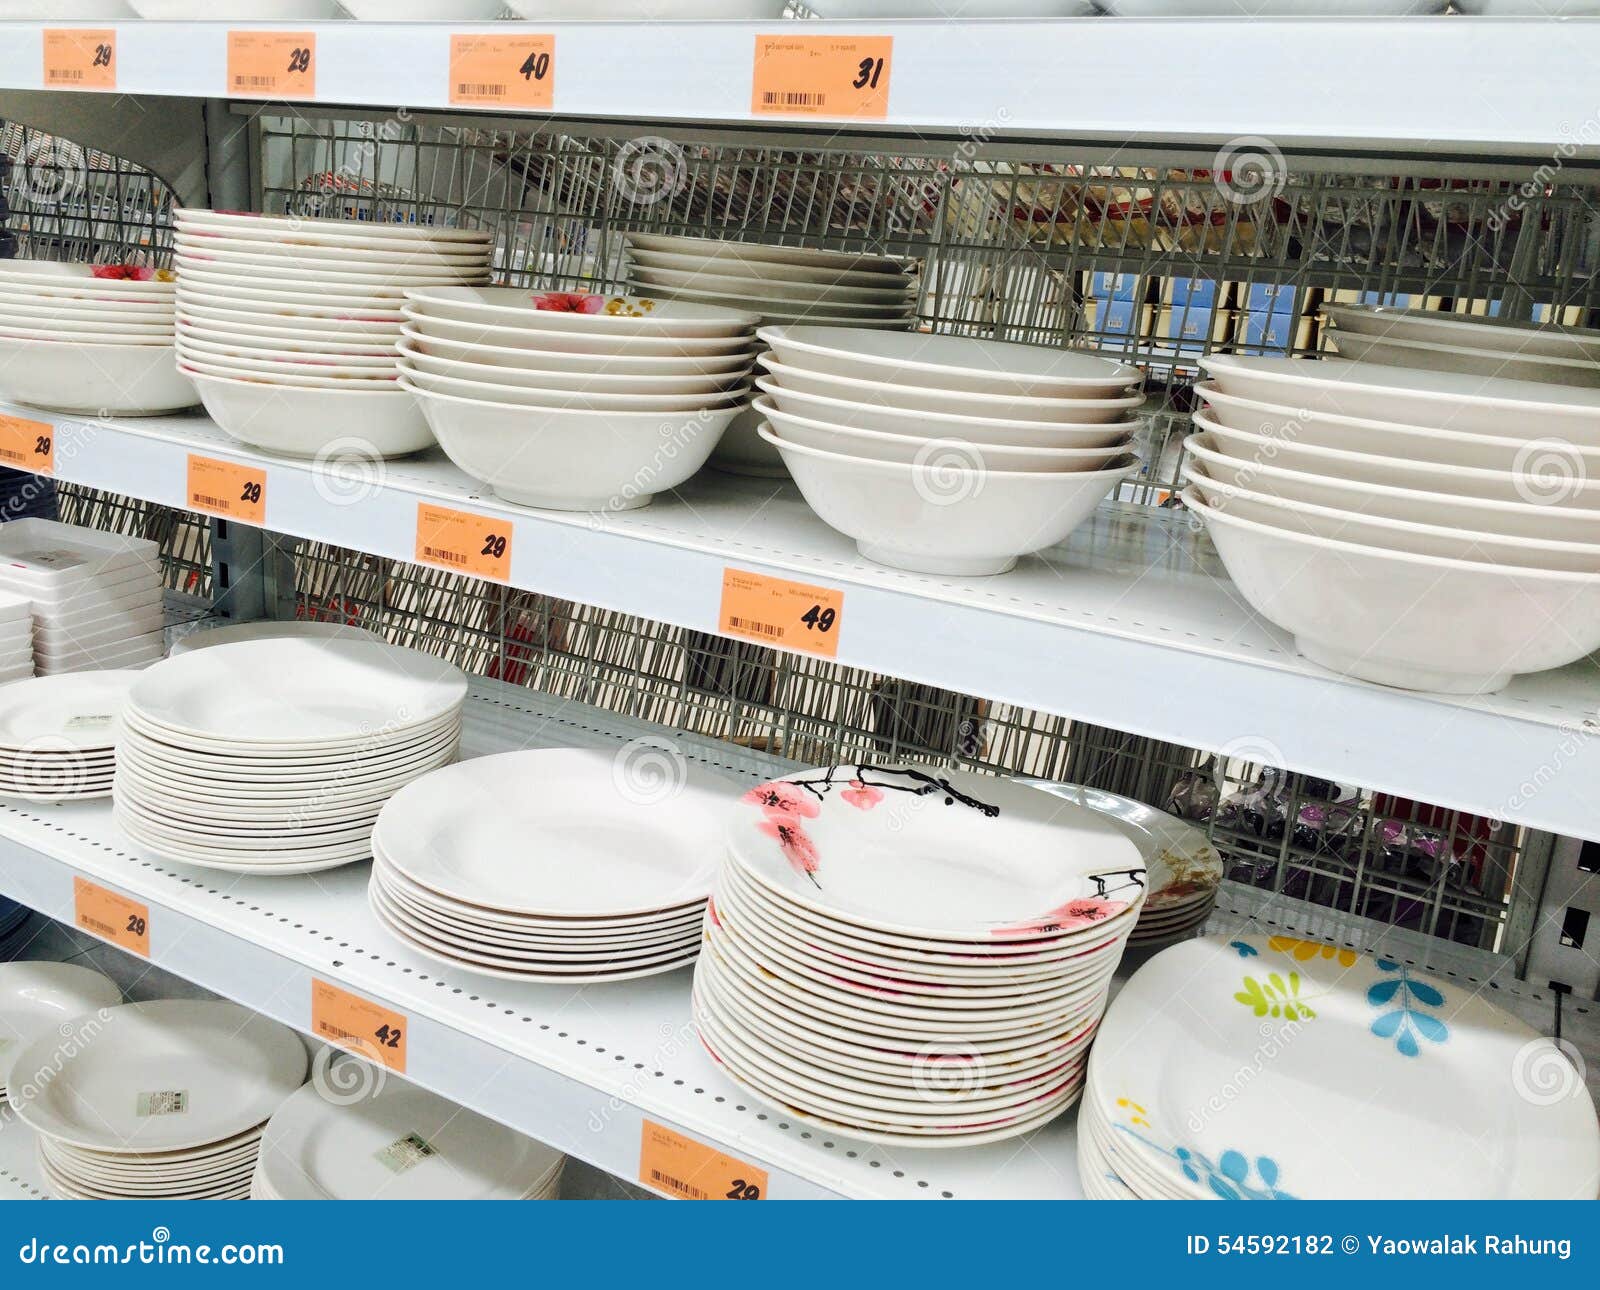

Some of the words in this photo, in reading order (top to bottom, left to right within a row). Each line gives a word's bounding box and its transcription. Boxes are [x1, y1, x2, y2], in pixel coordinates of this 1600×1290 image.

[93, 44, 112, 67] 29
[287, 48, 311, 73] 29
[519, 52, 550, 80] 40
[852, 57, 884, 89] 31
[34, 435, 51, 456] 29
[240, 481, 261, 504] 29
[480, 534, 507, 558] 29
[801, 604, 836, 633] 49
[126, 914, 146, 937] 29
[374, 1023, 402, 1048] 42
[725, 1179, 760, 1200] 29
